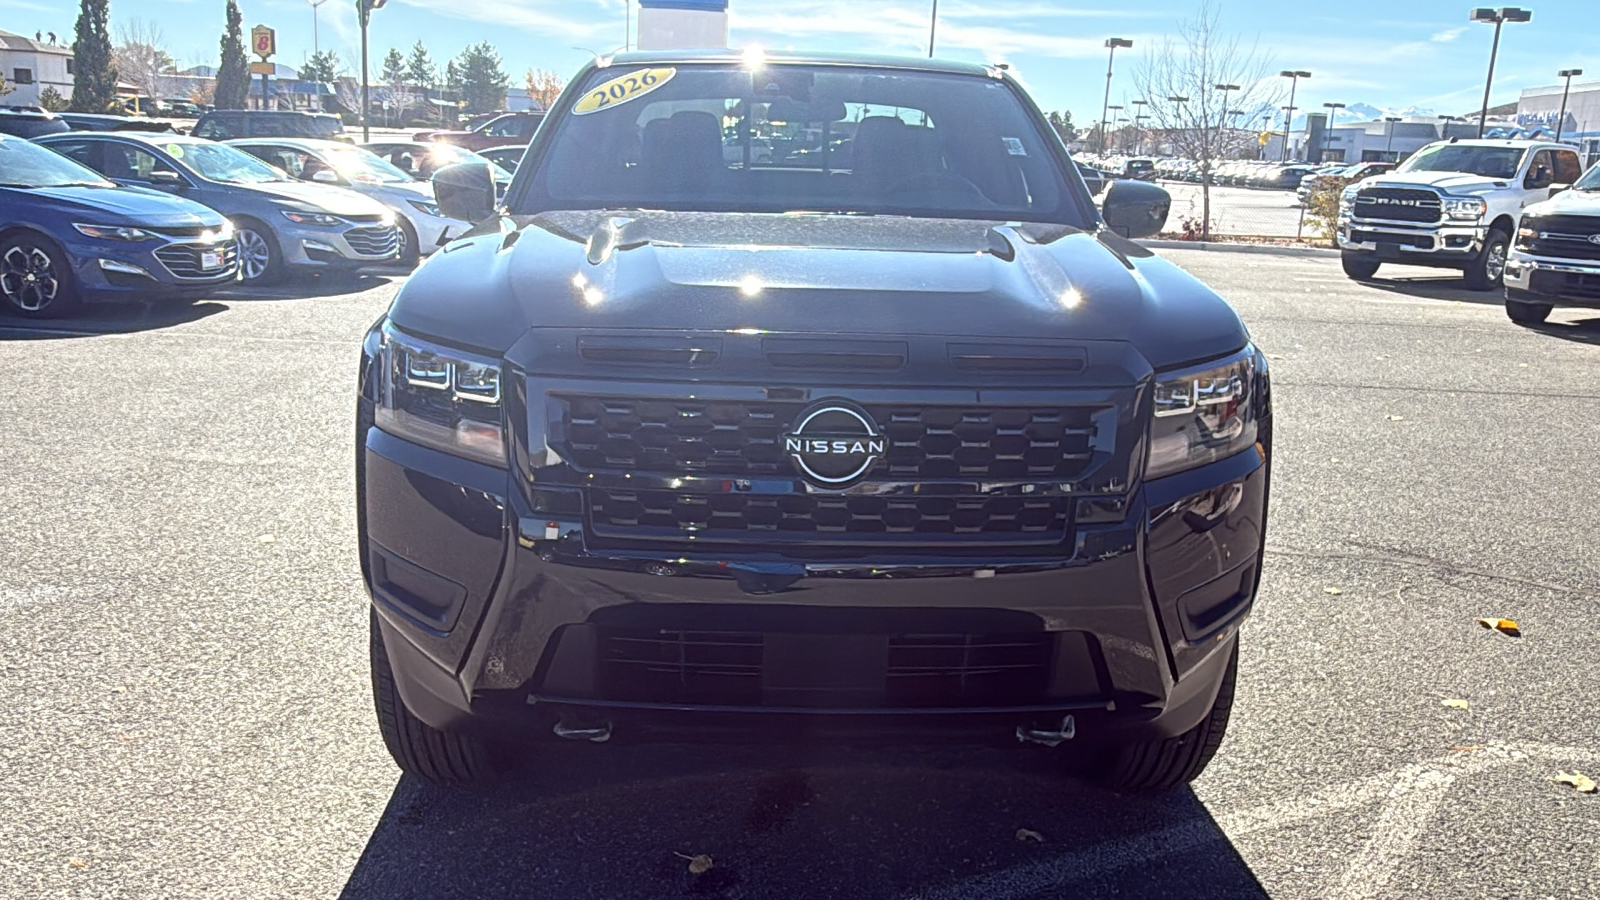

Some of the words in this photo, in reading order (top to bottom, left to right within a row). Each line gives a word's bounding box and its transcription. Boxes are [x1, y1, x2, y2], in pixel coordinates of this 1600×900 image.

[593, 72, 657, 107] 2026
[1377, 198, 1414, 207] RAM
[786, 438, 884, 454] NISSAN
